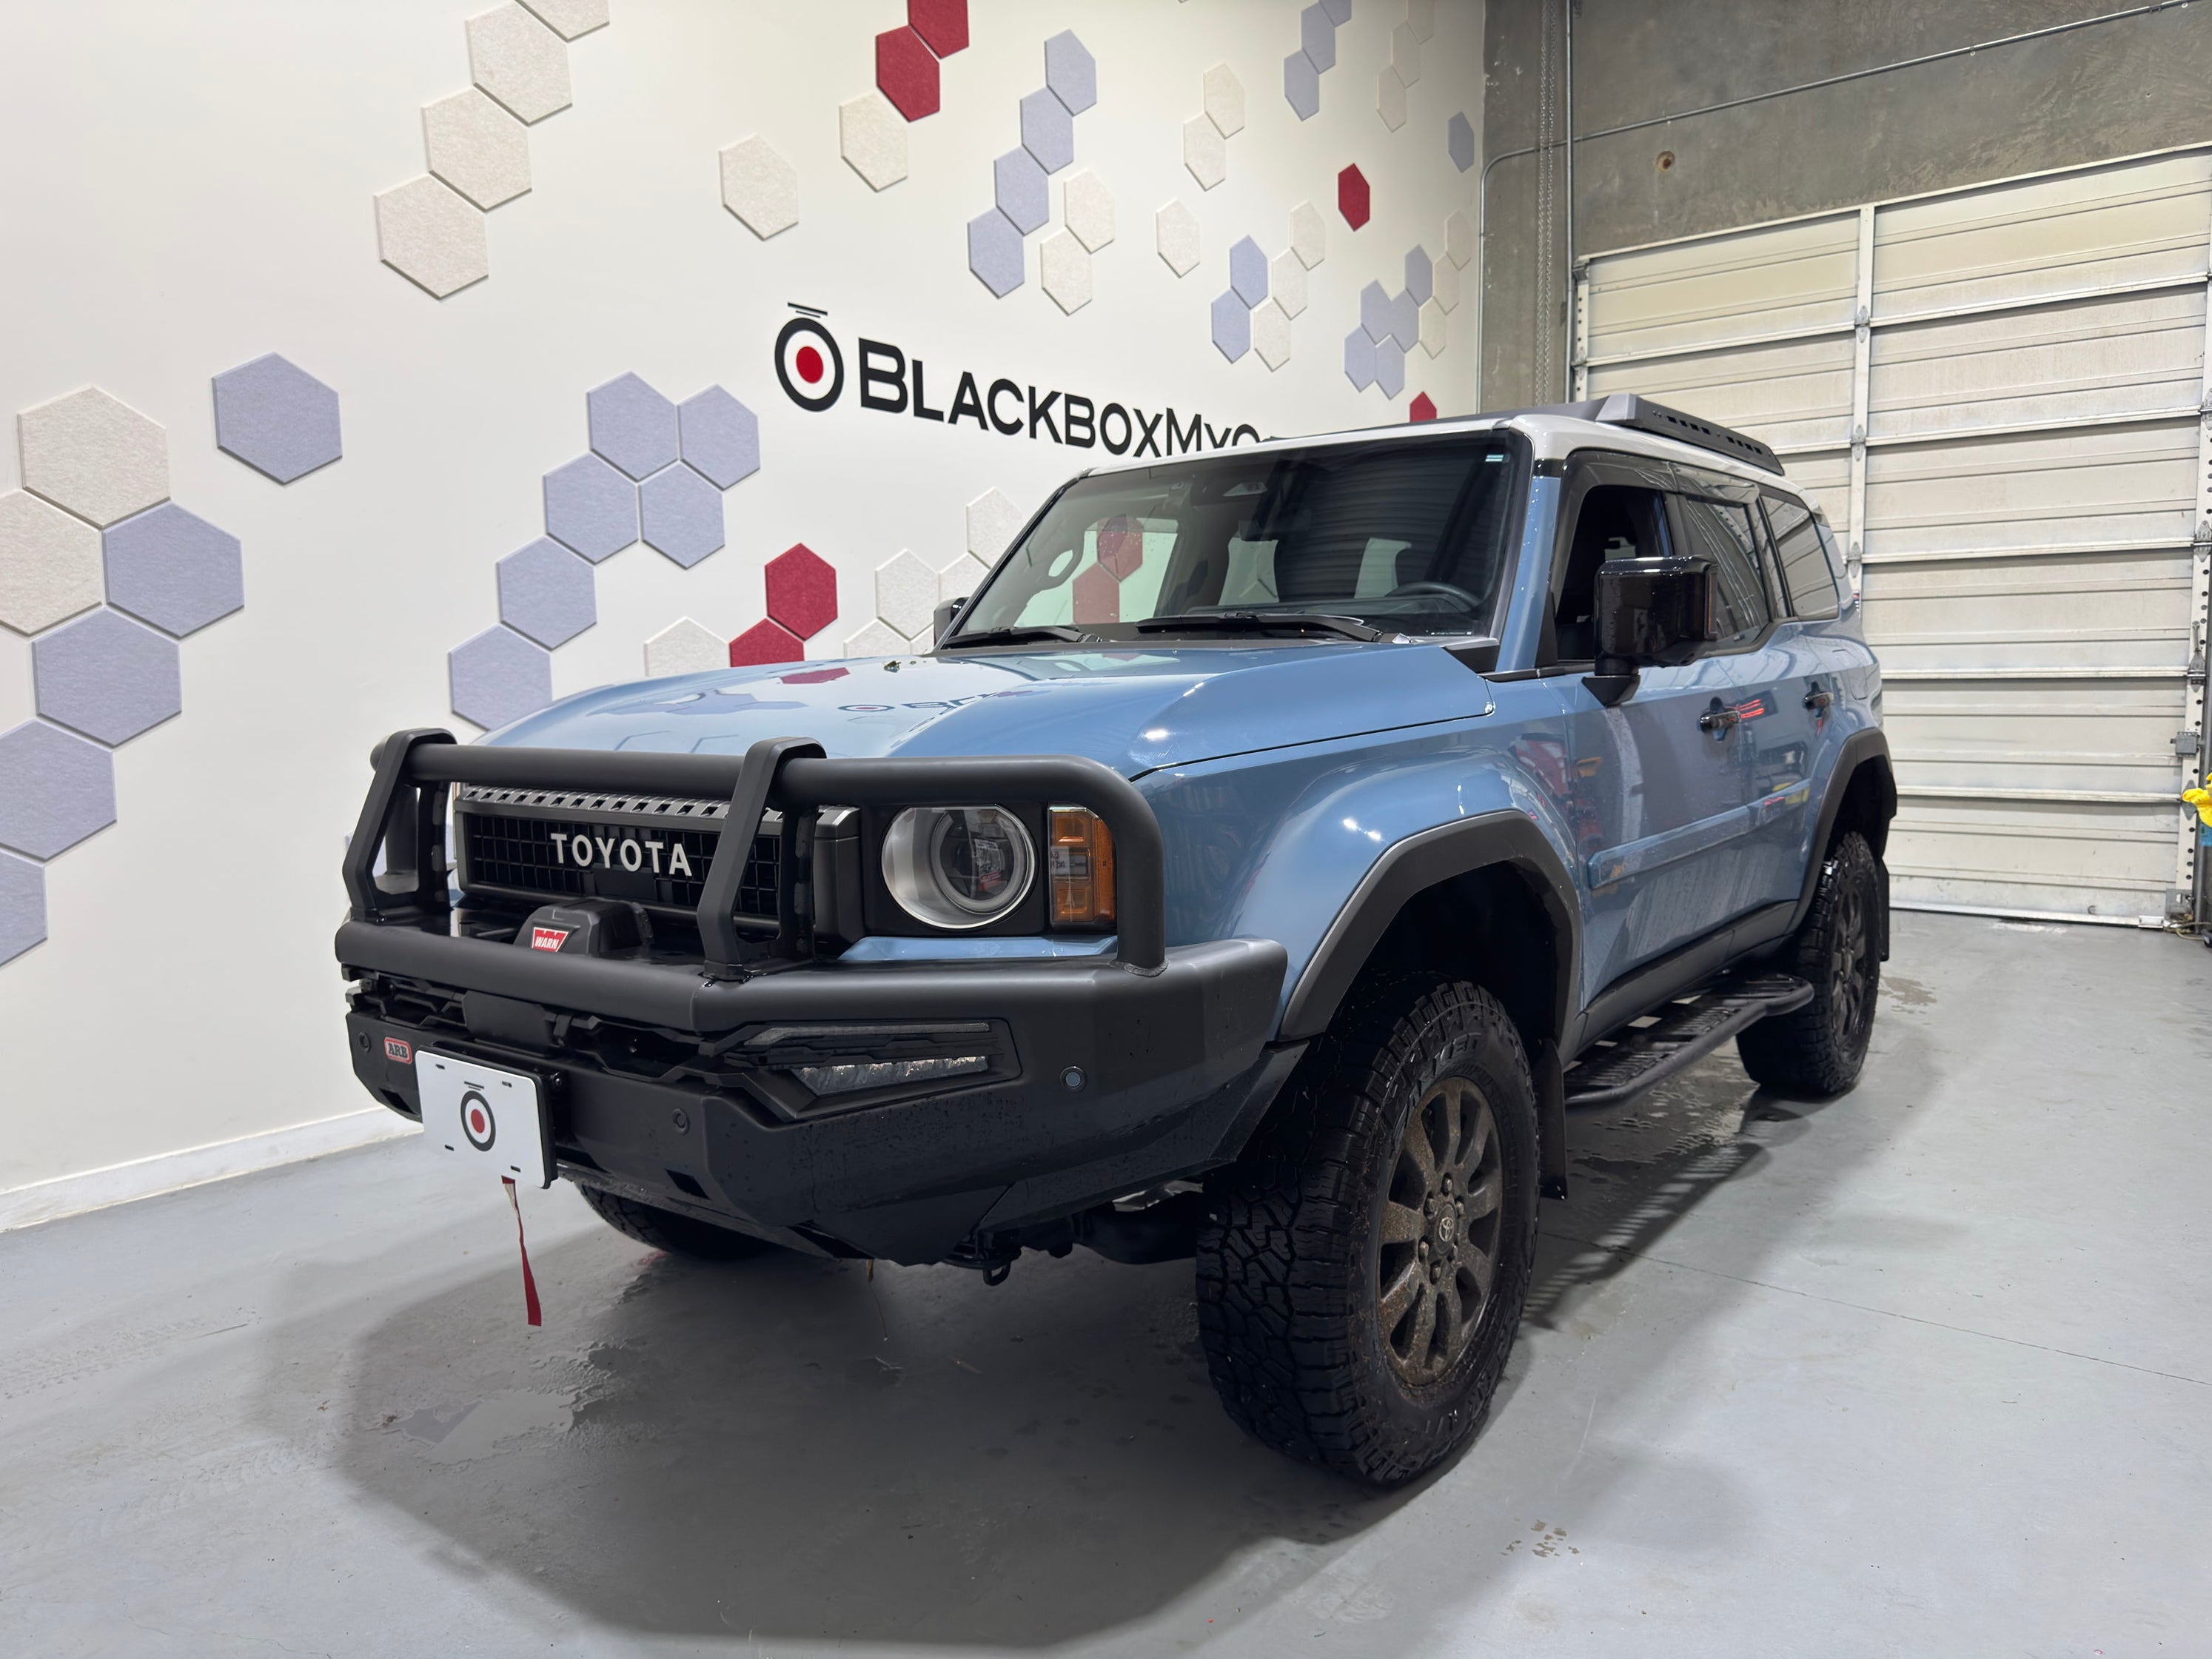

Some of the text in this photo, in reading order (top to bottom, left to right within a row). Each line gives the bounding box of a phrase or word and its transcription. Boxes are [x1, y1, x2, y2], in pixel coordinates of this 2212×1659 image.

[550, 832, 692, 877] TOYOTA
[534, 936, 560, 950] WARN
[388, 1042, 409, 1059] ARB
